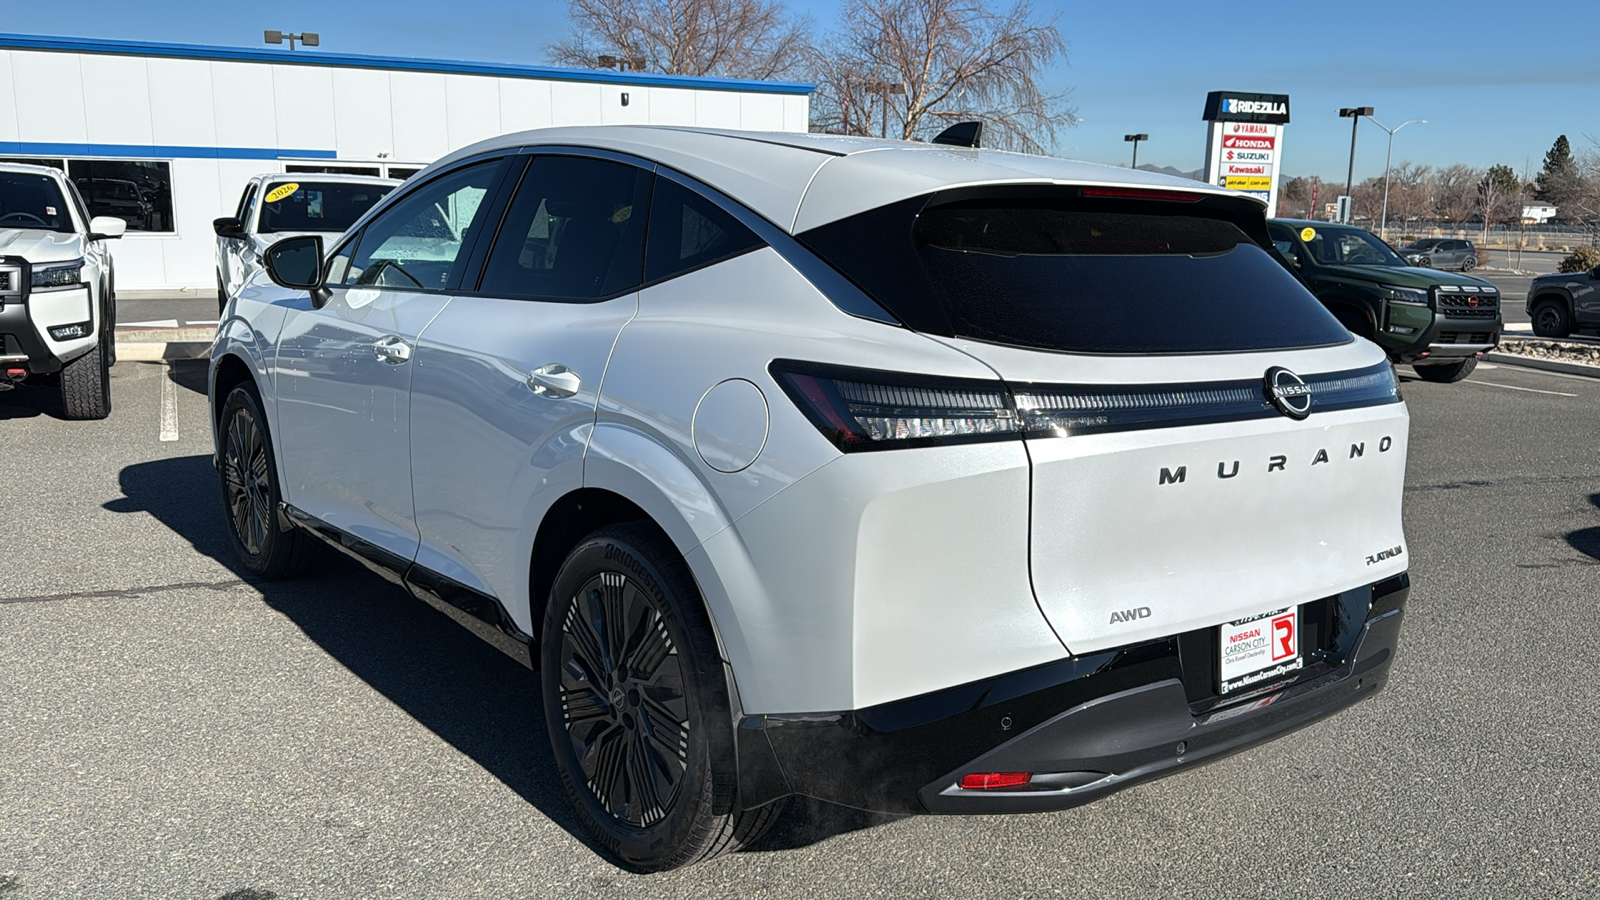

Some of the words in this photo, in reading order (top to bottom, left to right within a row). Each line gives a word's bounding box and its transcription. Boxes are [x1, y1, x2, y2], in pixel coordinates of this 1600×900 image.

[1237, 100, 1287, 115] RIDEZILLA
[1241, 124, 1268, 134] YAMAHA
[1235, 139, 1272, 148] HONDA
[1236, 152, 1269, 160] SUZUKI
[1228, 165, 1265, 174] Kawasaki
[271, 184, 294, 199] 2026
[1274, 385, 1312, 397] NISSAN
[1158, 435, 1393, 485] MURANO
[1365, 545, 1403, 566] PLATINUM
[604, 543, 677, 624] BRIDGESTONE
[1109, 606, 1152, 625] AWD
[1229, 629, 1261, 643] NISSAN
[1274, 619, 1294, 655] R
[1225, 641, 1252, 655] CARSON
[1252, 637, 1266, 648] CITY
[1225, 655, 1236, 665] Chris
[1247, 649, 1266, 659] Dealership
[1228, 664, 1297, 690] www.NissanCarsonCity.com
